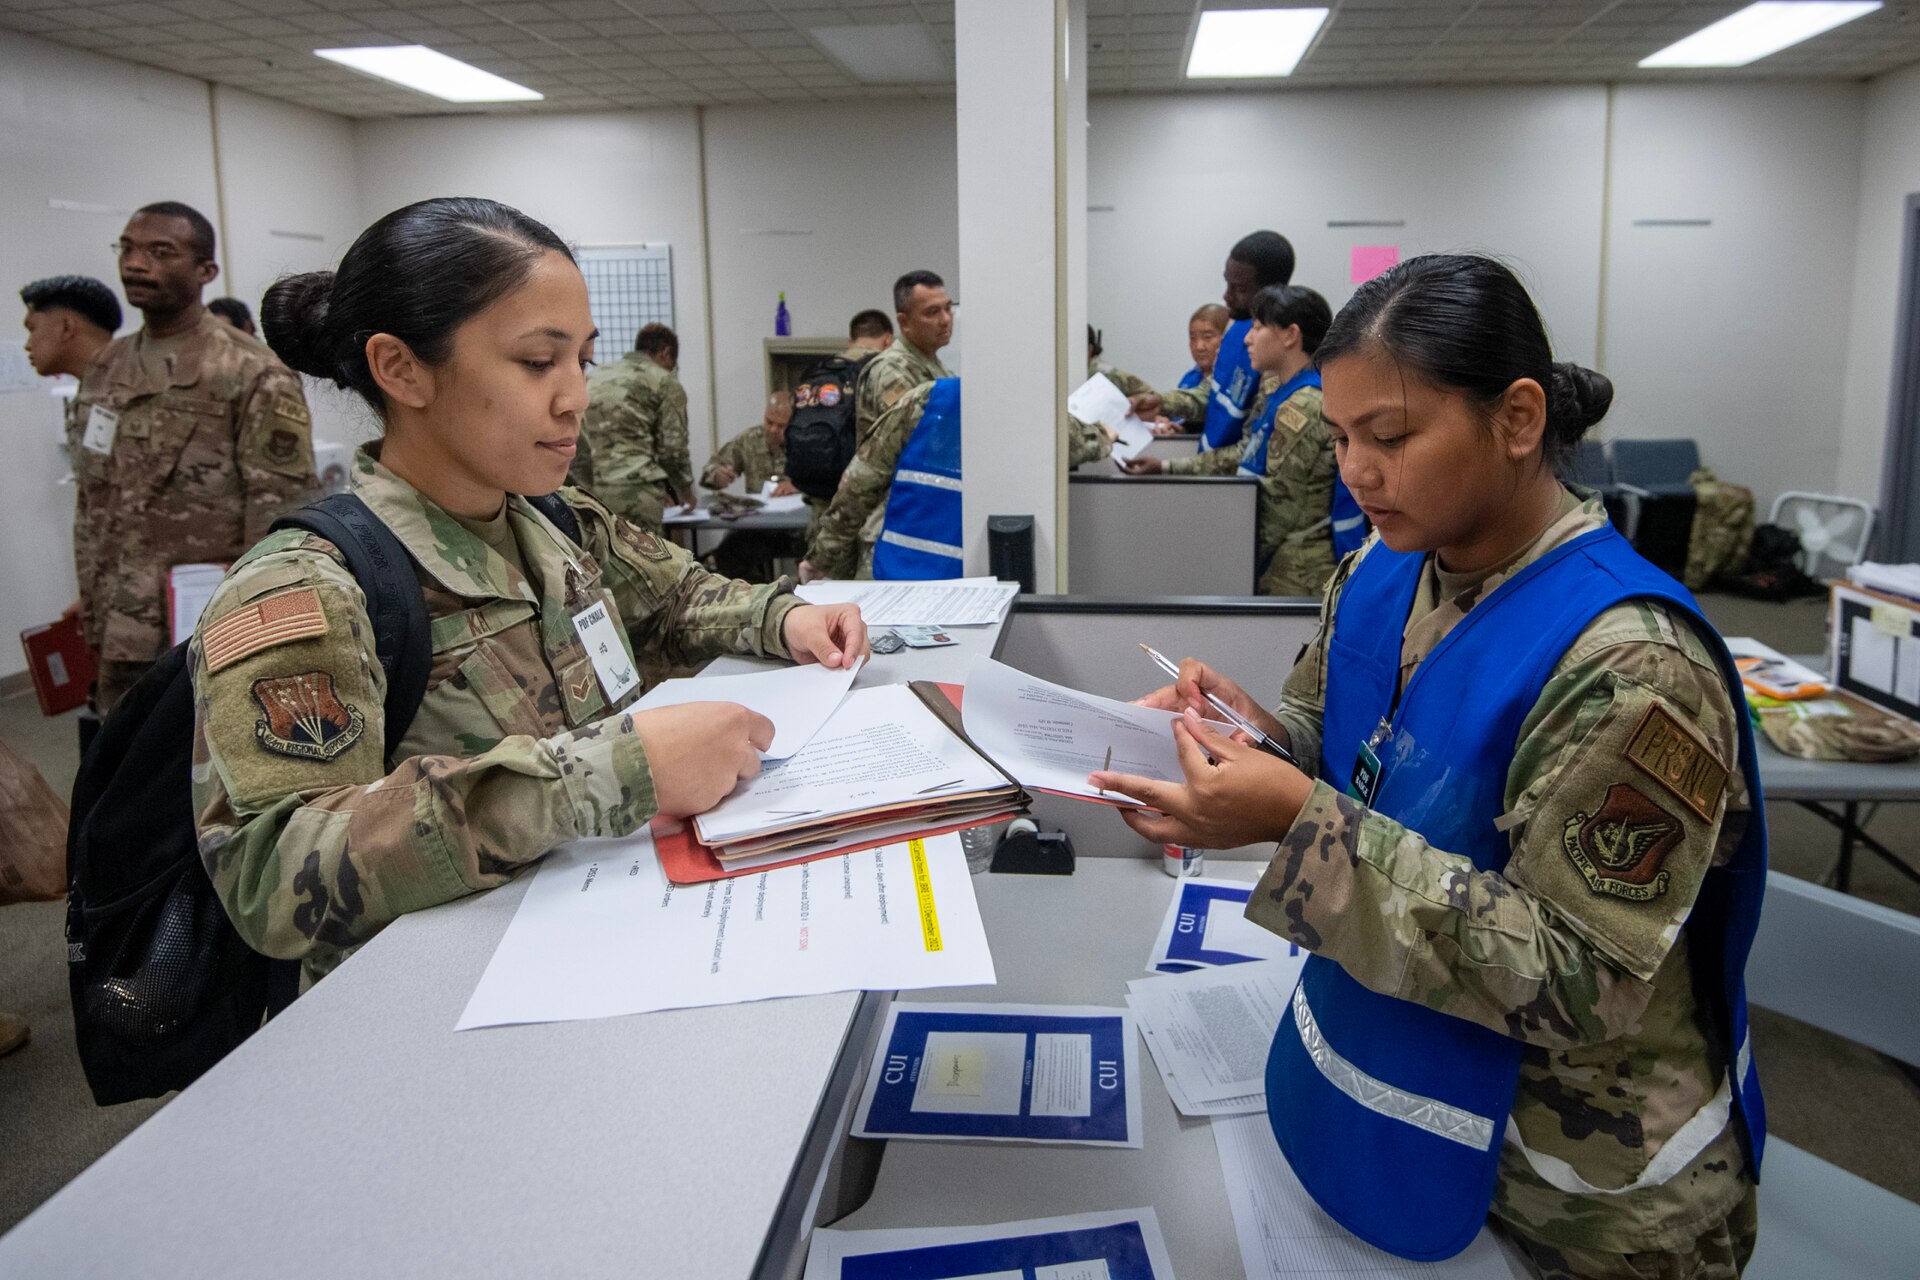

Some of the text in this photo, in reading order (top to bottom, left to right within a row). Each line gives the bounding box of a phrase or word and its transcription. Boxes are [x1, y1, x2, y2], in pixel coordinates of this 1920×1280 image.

[578, 608, 605, 631] PDF CHALK
[287, 743, 322, 757] REGIONAL
[325, 734, 349, 755] SUPPORT
[348, 718, 362, 737] GROUP
[1640, 722, 1712, 807] PRSNL
[1566, 836, 1649, 898] PACIFIC AIR FORCES
[581, 878, 595, 892] Memo
[725, 884, 733, 896] Form
[661, 892, 671, 908] orders
[702, 900, 712, 918] entirely
[924, 908, 935, 936] December
[1178, 912, 1196, 934] CUI
[929, 937, 940, 952] 2023
[885, 1054, 908, 1085] CUI
[909, 1056, 921, 1083] ATTENTION
[1099, 1060, 1118, 1090] CUI
